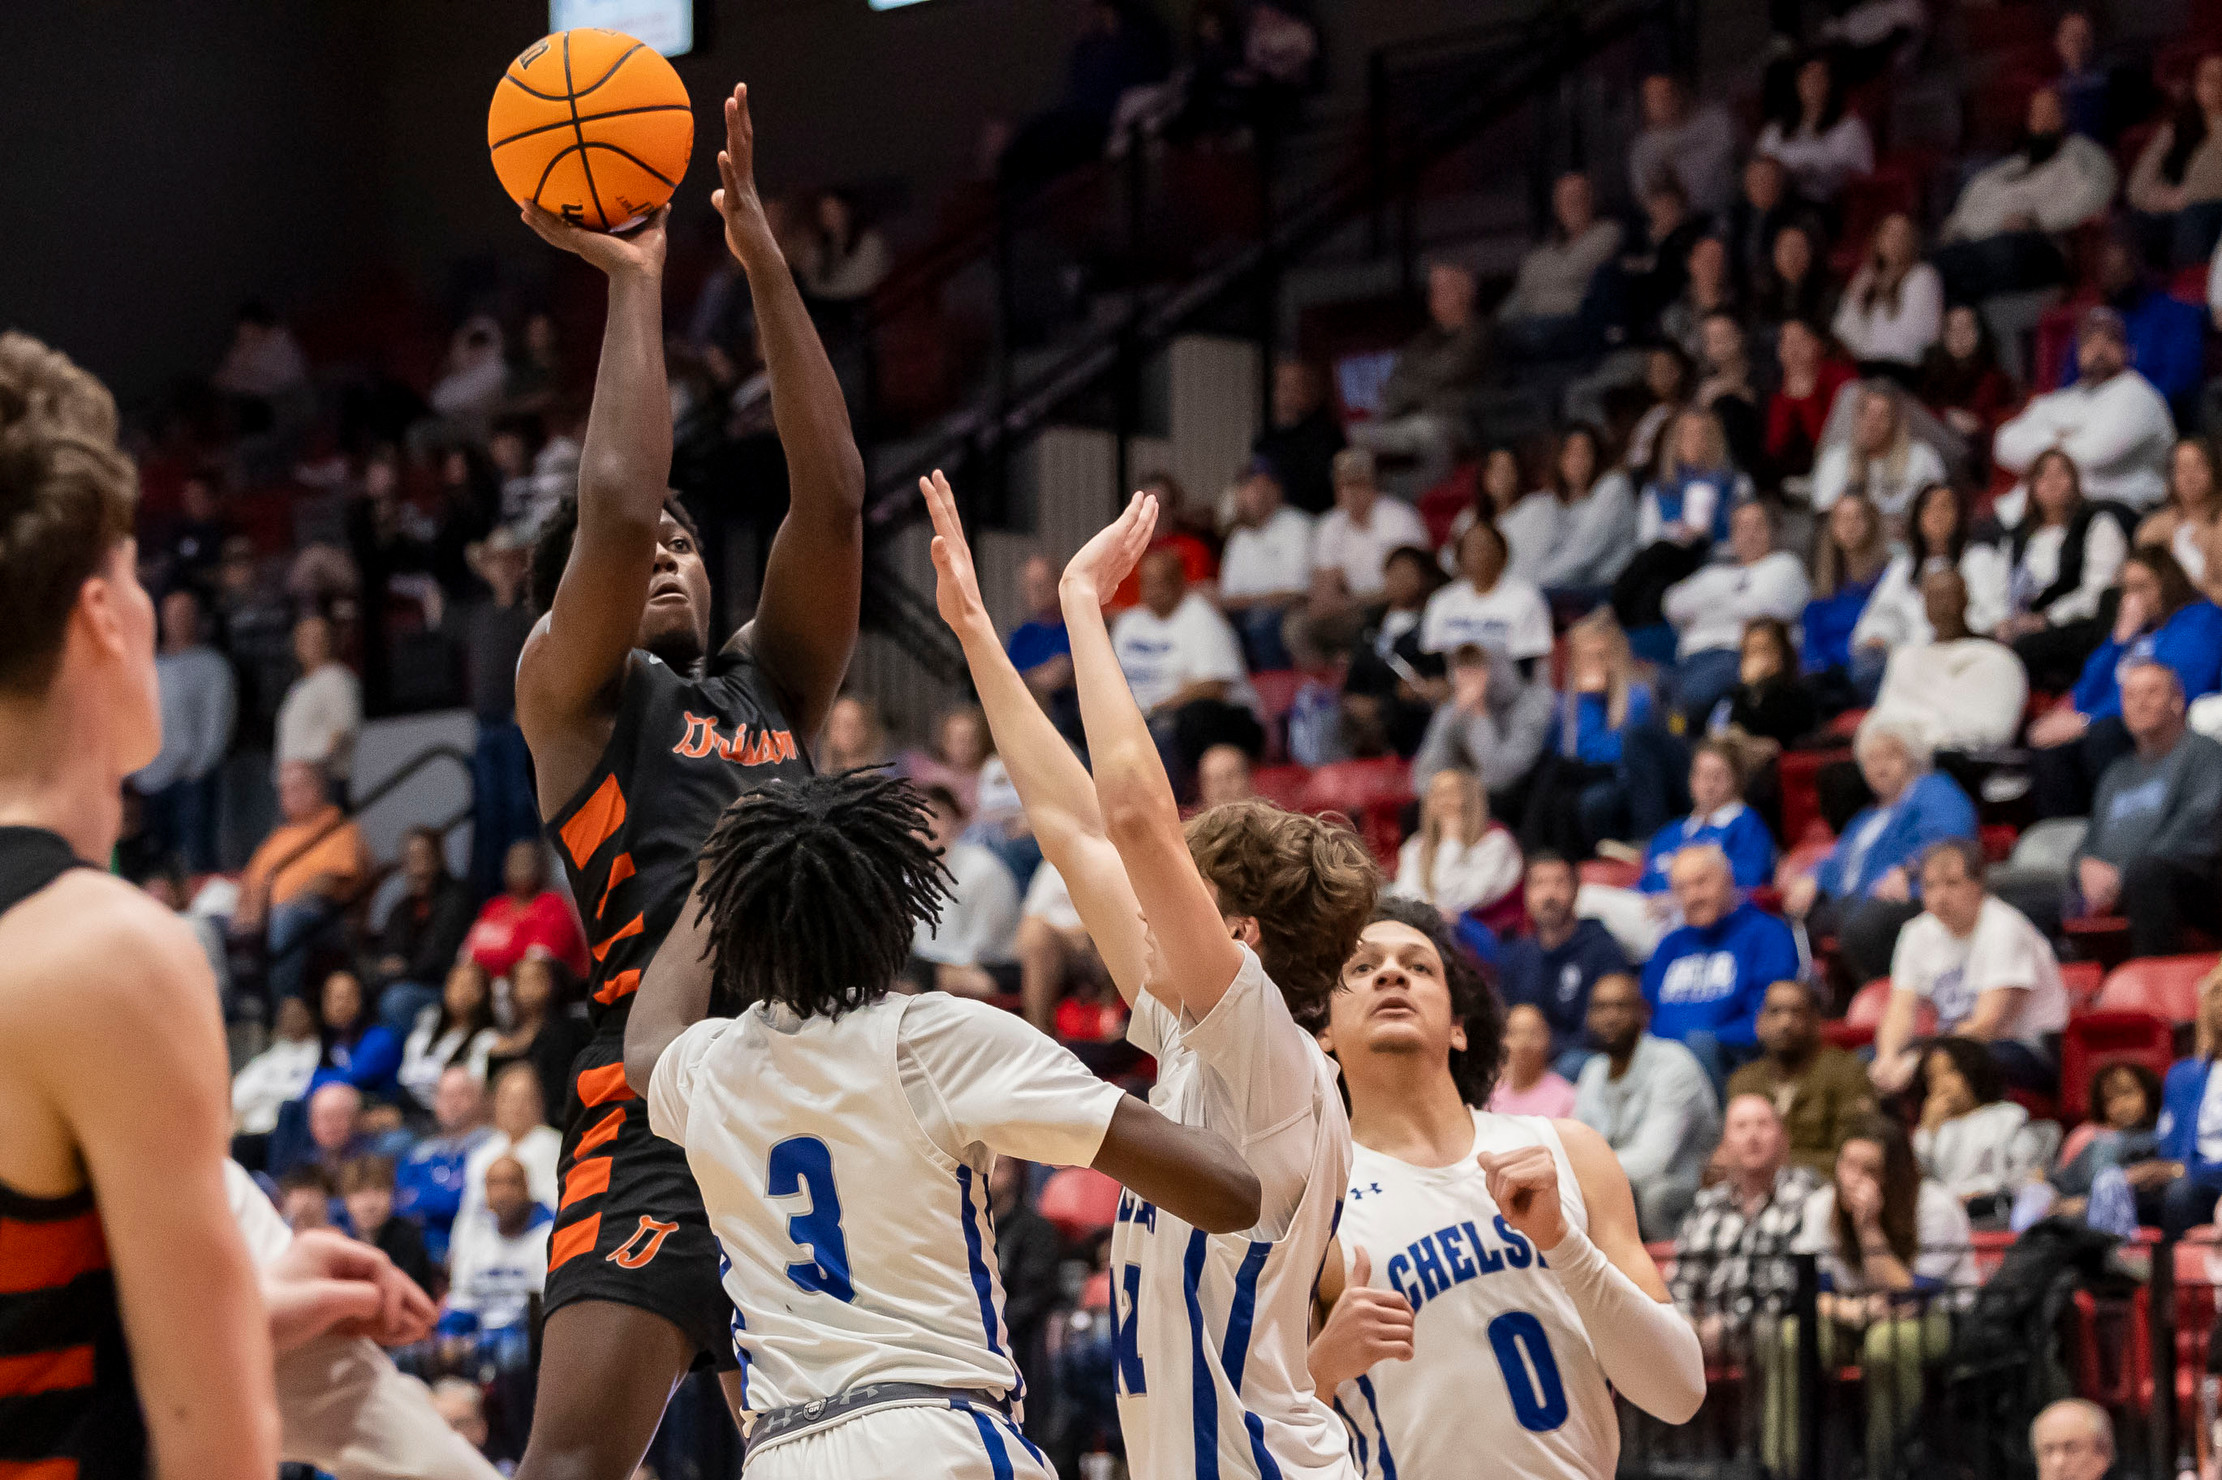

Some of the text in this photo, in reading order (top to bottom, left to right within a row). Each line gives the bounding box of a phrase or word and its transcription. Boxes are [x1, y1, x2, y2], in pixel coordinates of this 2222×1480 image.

[764, 1133, 858, 1305] 3
[1387, 1214, 1551, 1316] CHELS
[1486, 1310, 1570, 1433] 0
